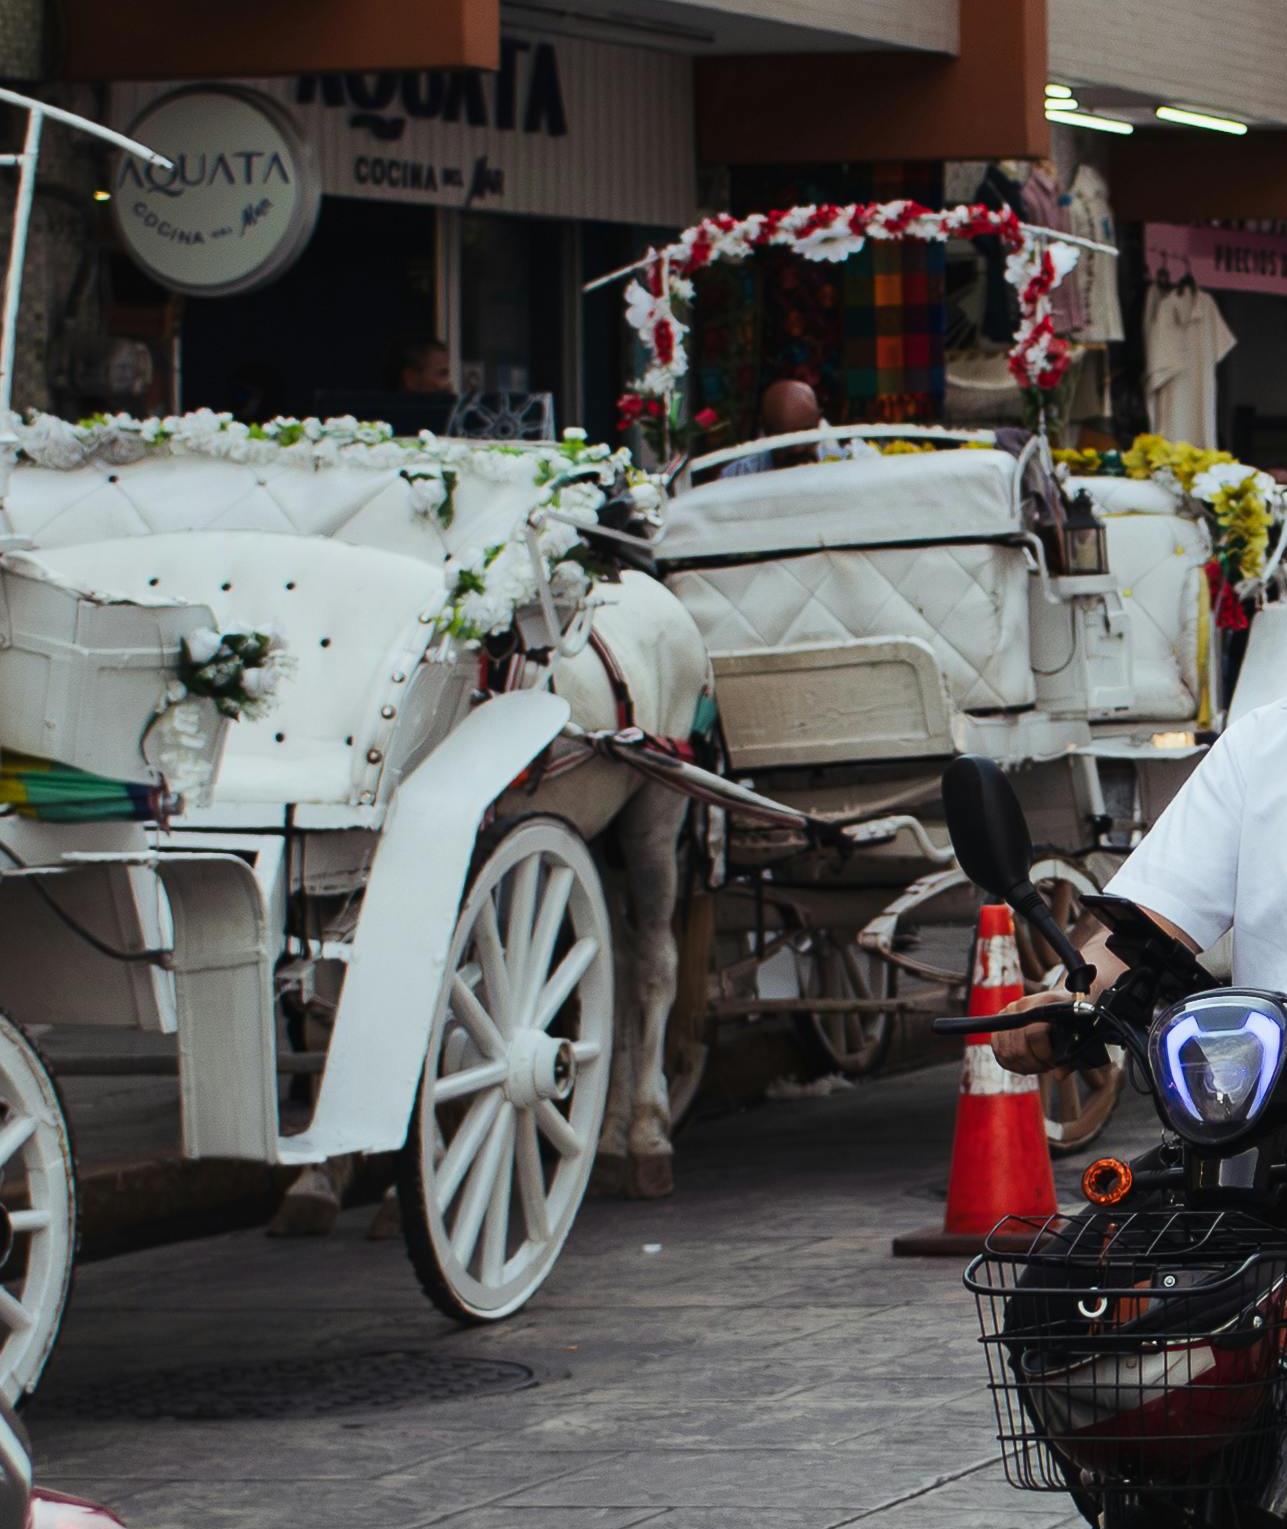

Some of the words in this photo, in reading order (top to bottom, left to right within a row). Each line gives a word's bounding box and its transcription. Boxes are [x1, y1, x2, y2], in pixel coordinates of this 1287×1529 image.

[118, 150, 290, 198] AQUATA
[353, 156, 438, 192] COCINA
[132, 200, 206, 245] COCINA
[1214, 244, 1278, 277] PRECIOS
